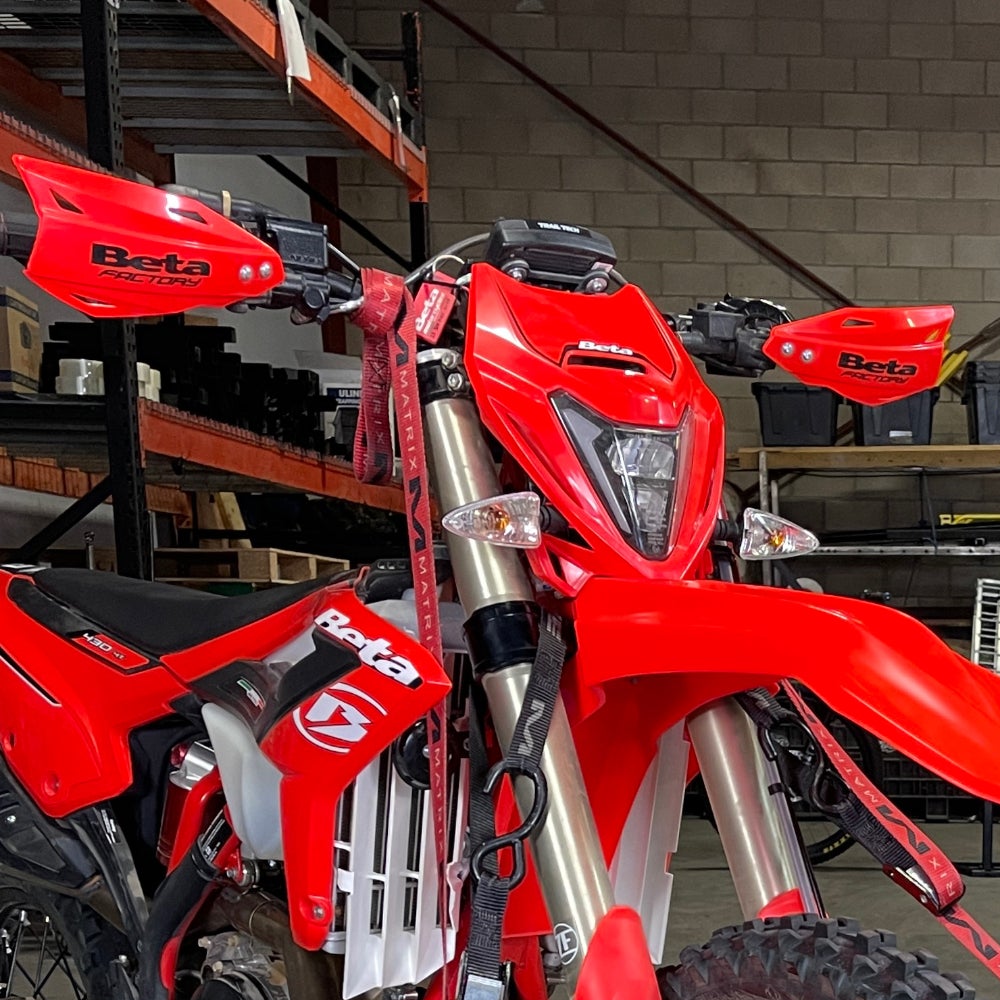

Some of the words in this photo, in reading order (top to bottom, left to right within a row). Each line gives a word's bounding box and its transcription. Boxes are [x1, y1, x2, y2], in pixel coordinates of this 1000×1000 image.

[537, 221, 561, 231] TRAIL
[561, 223, 580, 234] TECH
[91, 243, 211, 277] Beta
[98, 269, 203, 287] FACTORY
[414, 288, 440, 332] Beta
[577, 340, 634, 356] Beta
[837, 351, 918, 377] Beta
[840, 370, 910, 384] FACTORY
[338, 389, 361, 398] ULIN
[399, 370, 418, 470] MATRIX
[82, 632, 113, 652] 430
[314, 607, 423, 689] Beta
